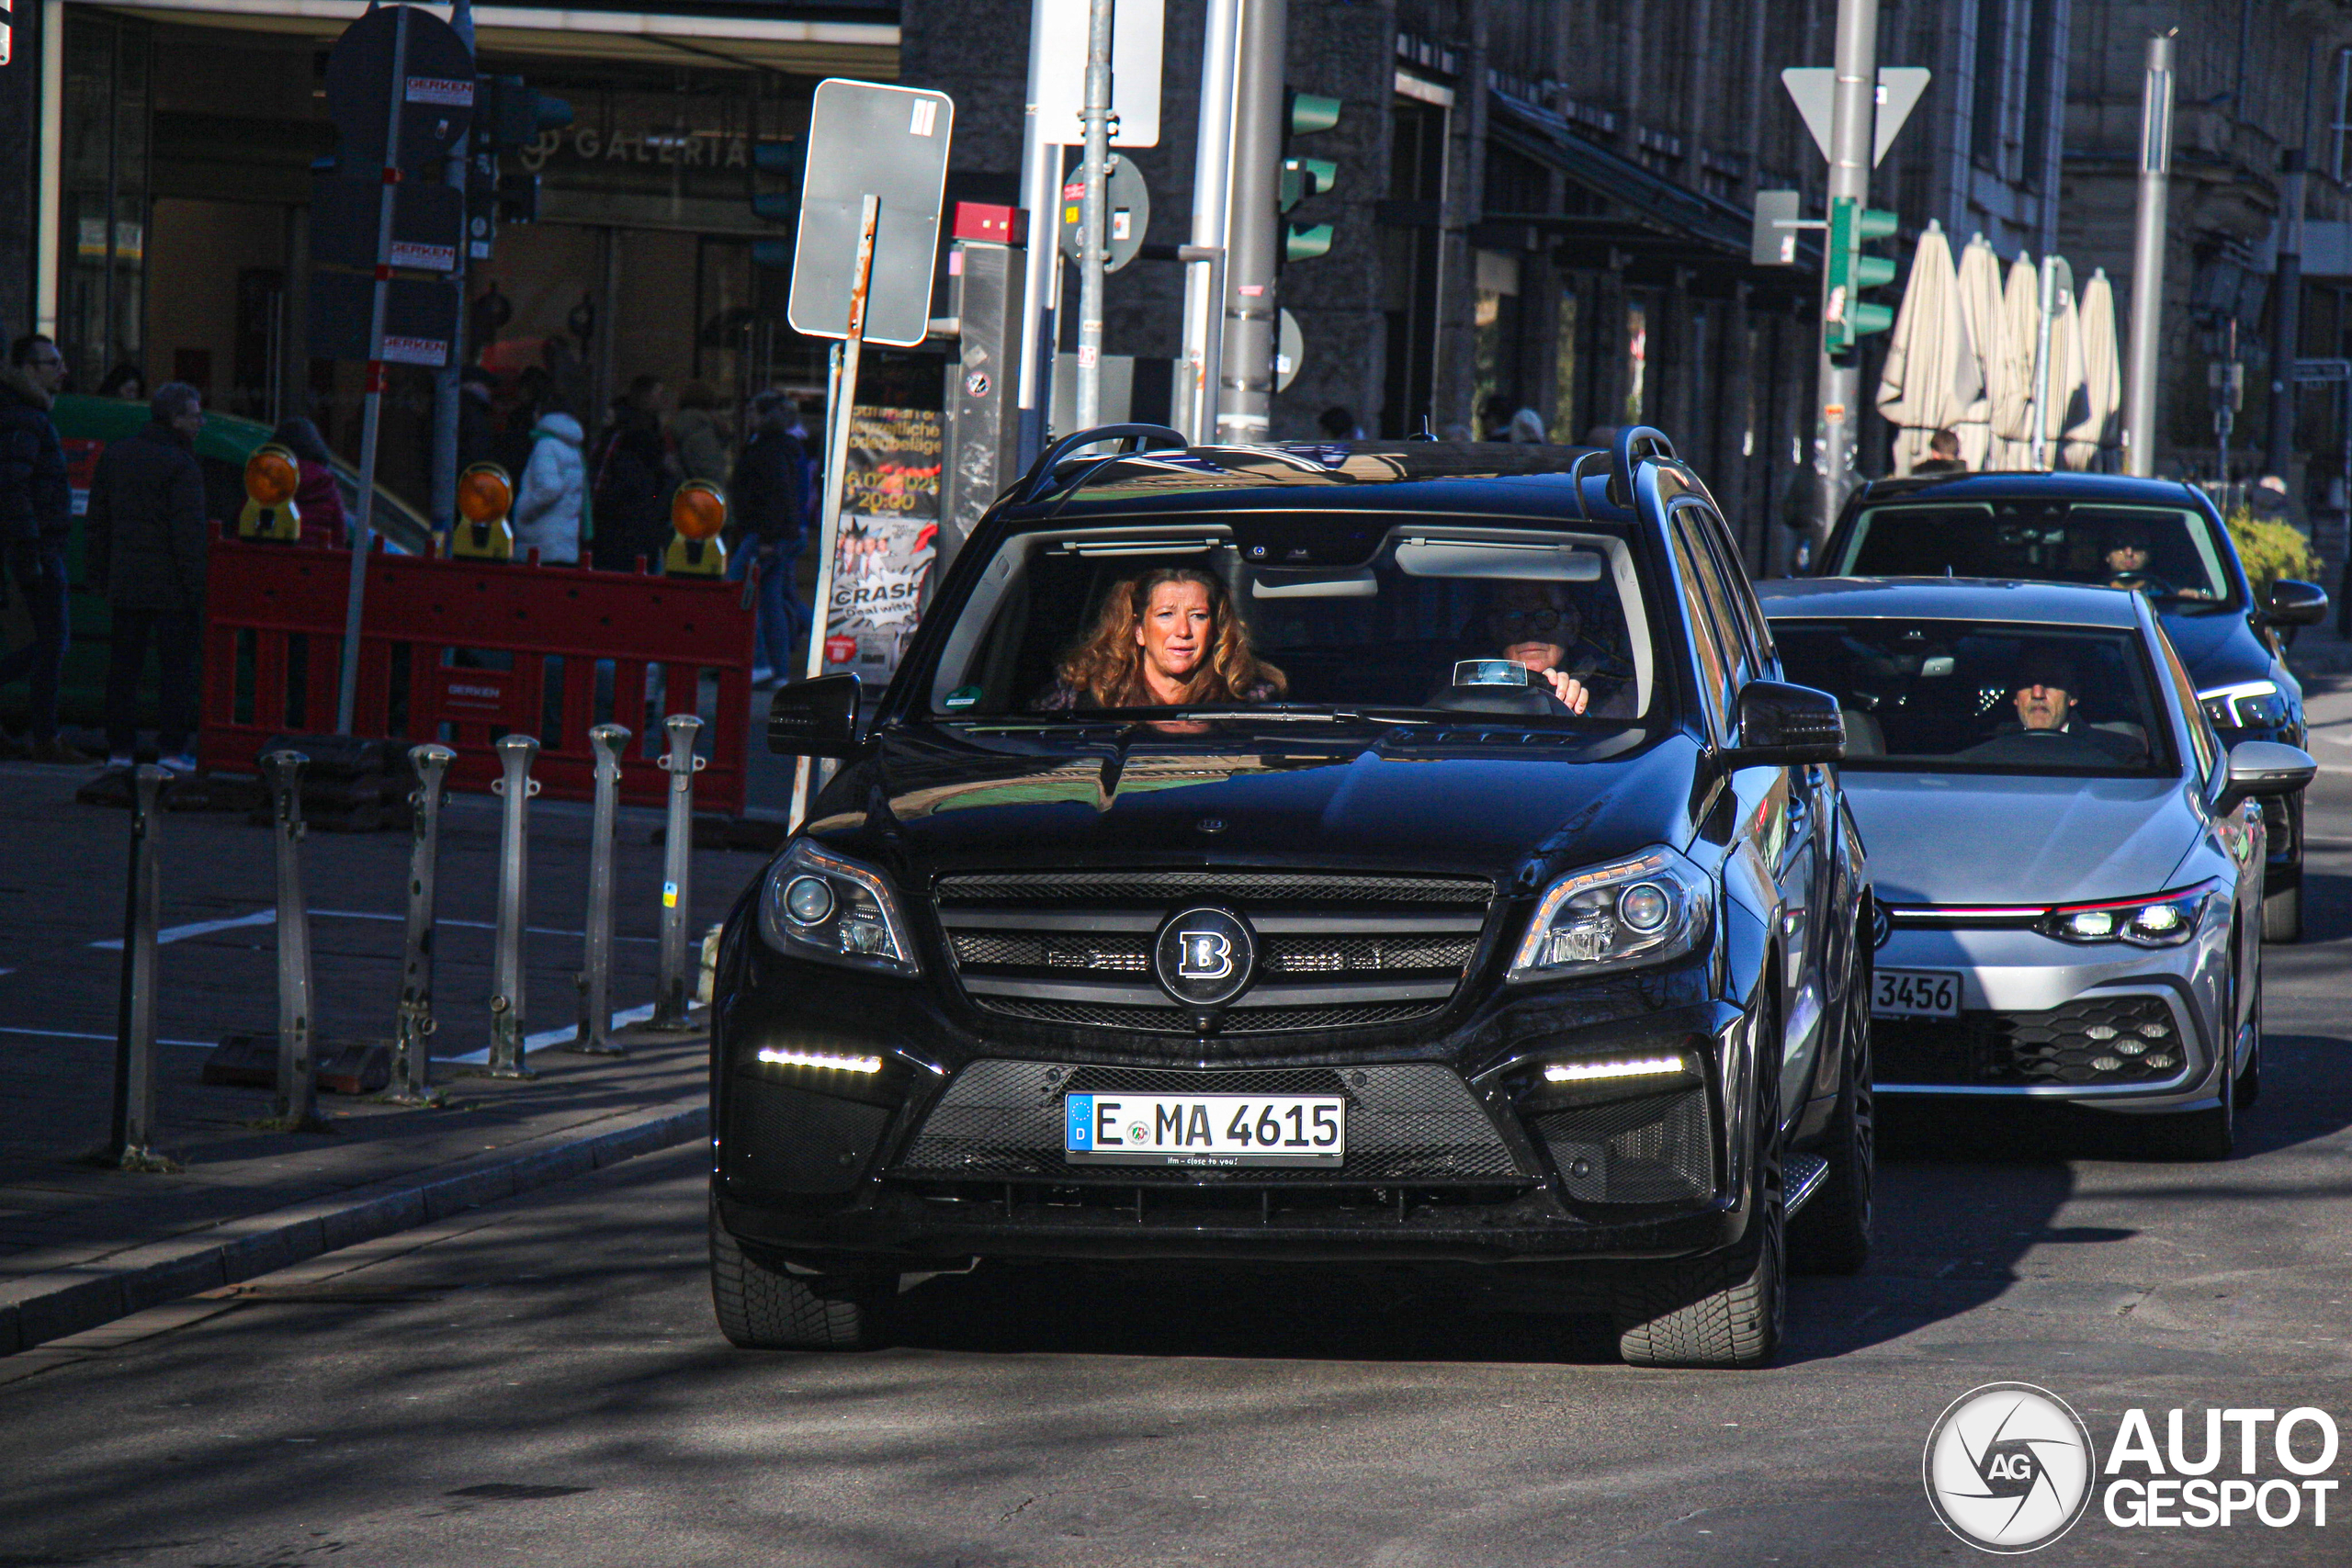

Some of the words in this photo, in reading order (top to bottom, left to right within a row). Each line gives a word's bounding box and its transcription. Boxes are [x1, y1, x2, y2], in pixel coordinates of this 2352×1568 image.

[408, 79, 473, 92] GERKEN
[575, 129, 747, 168] GALERIA
[392, 243, 454, 257] GERKEN
[385, 337, 446, 351] GERKEN
[852, 418, 941, 437] euzeitliche
[849, 434, 943, 456] odenbeläge
[858, 491, 916, 511] 20:00
[834, 581, 920, 605] CRASH
[880, 601, 912, 614] with
[1179, 931, 1232, 979] B
[1878, 976, 1952, 1010] 3456
[1076, 1128, 1085, 1140] D
[1097, 1103, 1123, 1145] E
[1156, 1104, 1213, 1146] MA
[1227, 1105, 1338, 1147] 4615
[1187, 1157, 1205, 1166] close
[1219, 1157, 1238, 1166] you!
